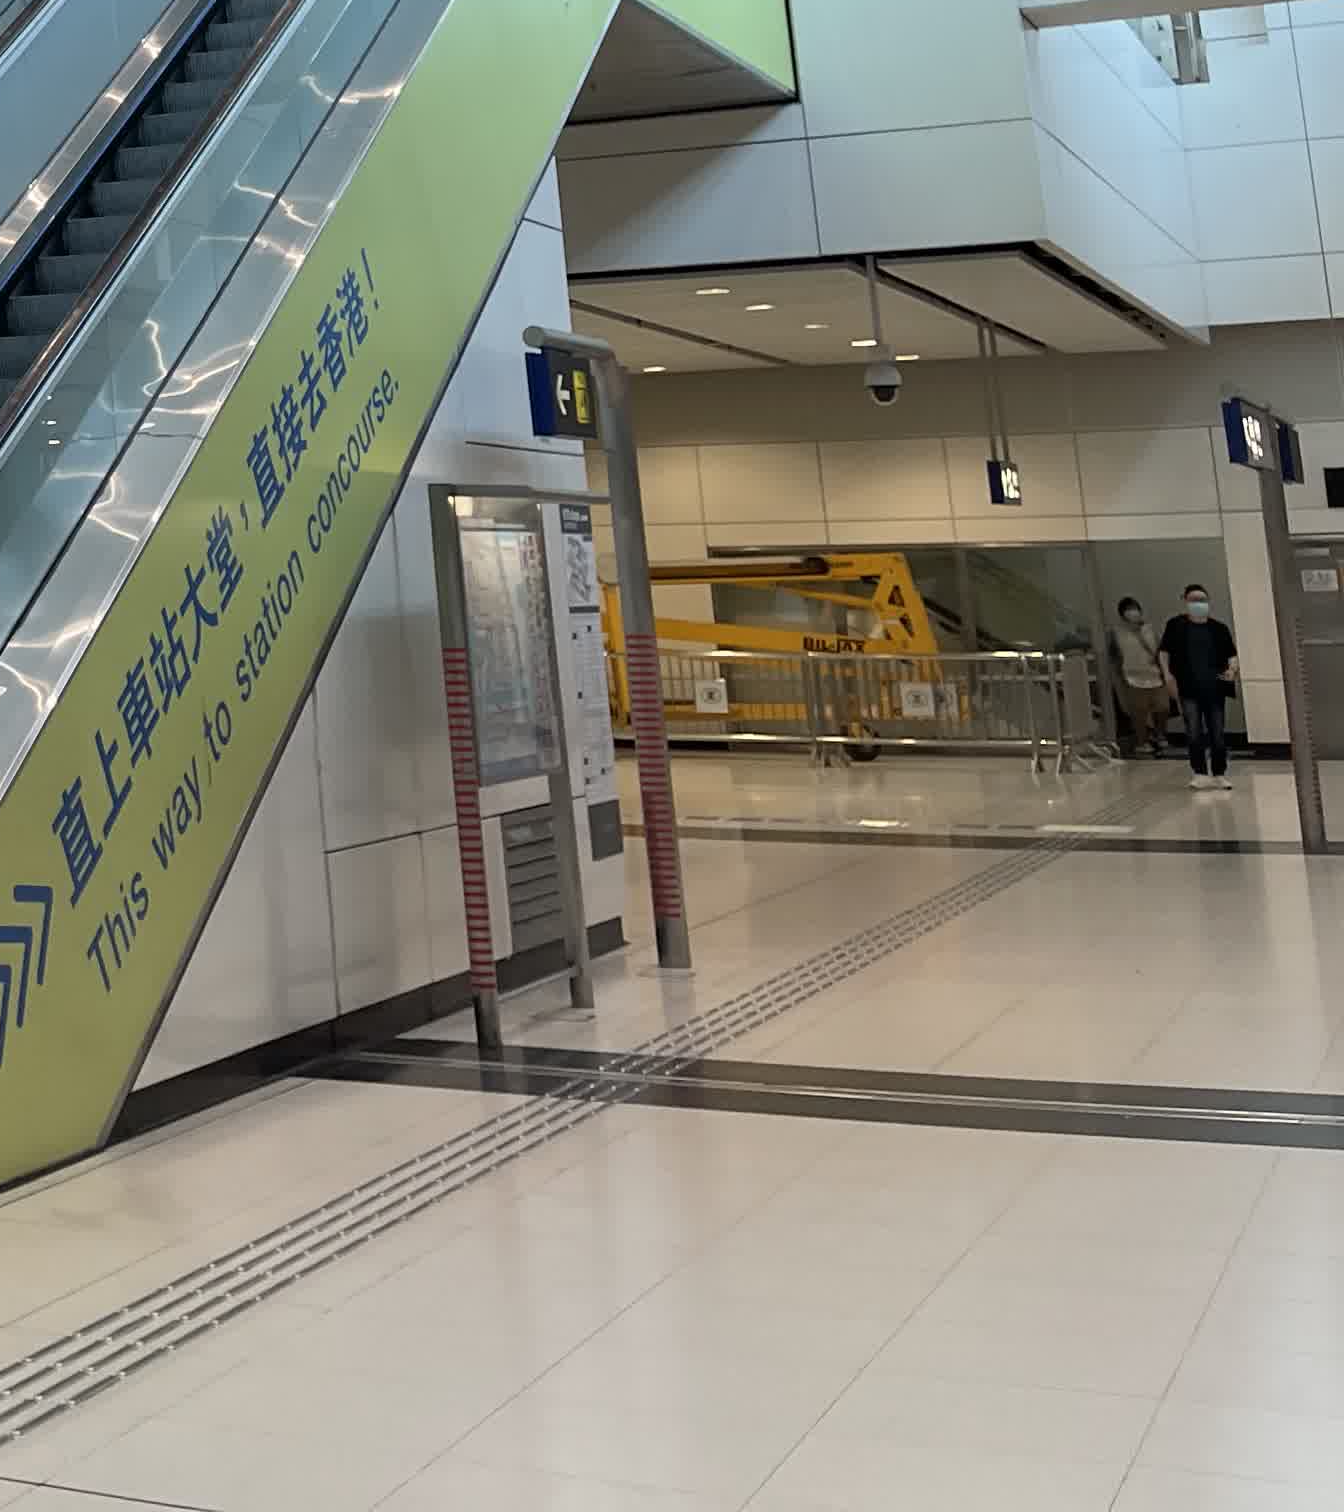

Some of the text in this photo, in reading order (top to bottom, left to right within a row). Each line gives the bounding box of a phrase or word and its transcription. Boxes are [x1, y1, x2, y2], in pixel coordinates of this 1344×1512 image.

[87, 367, 401, 993] This way to station concourse.
